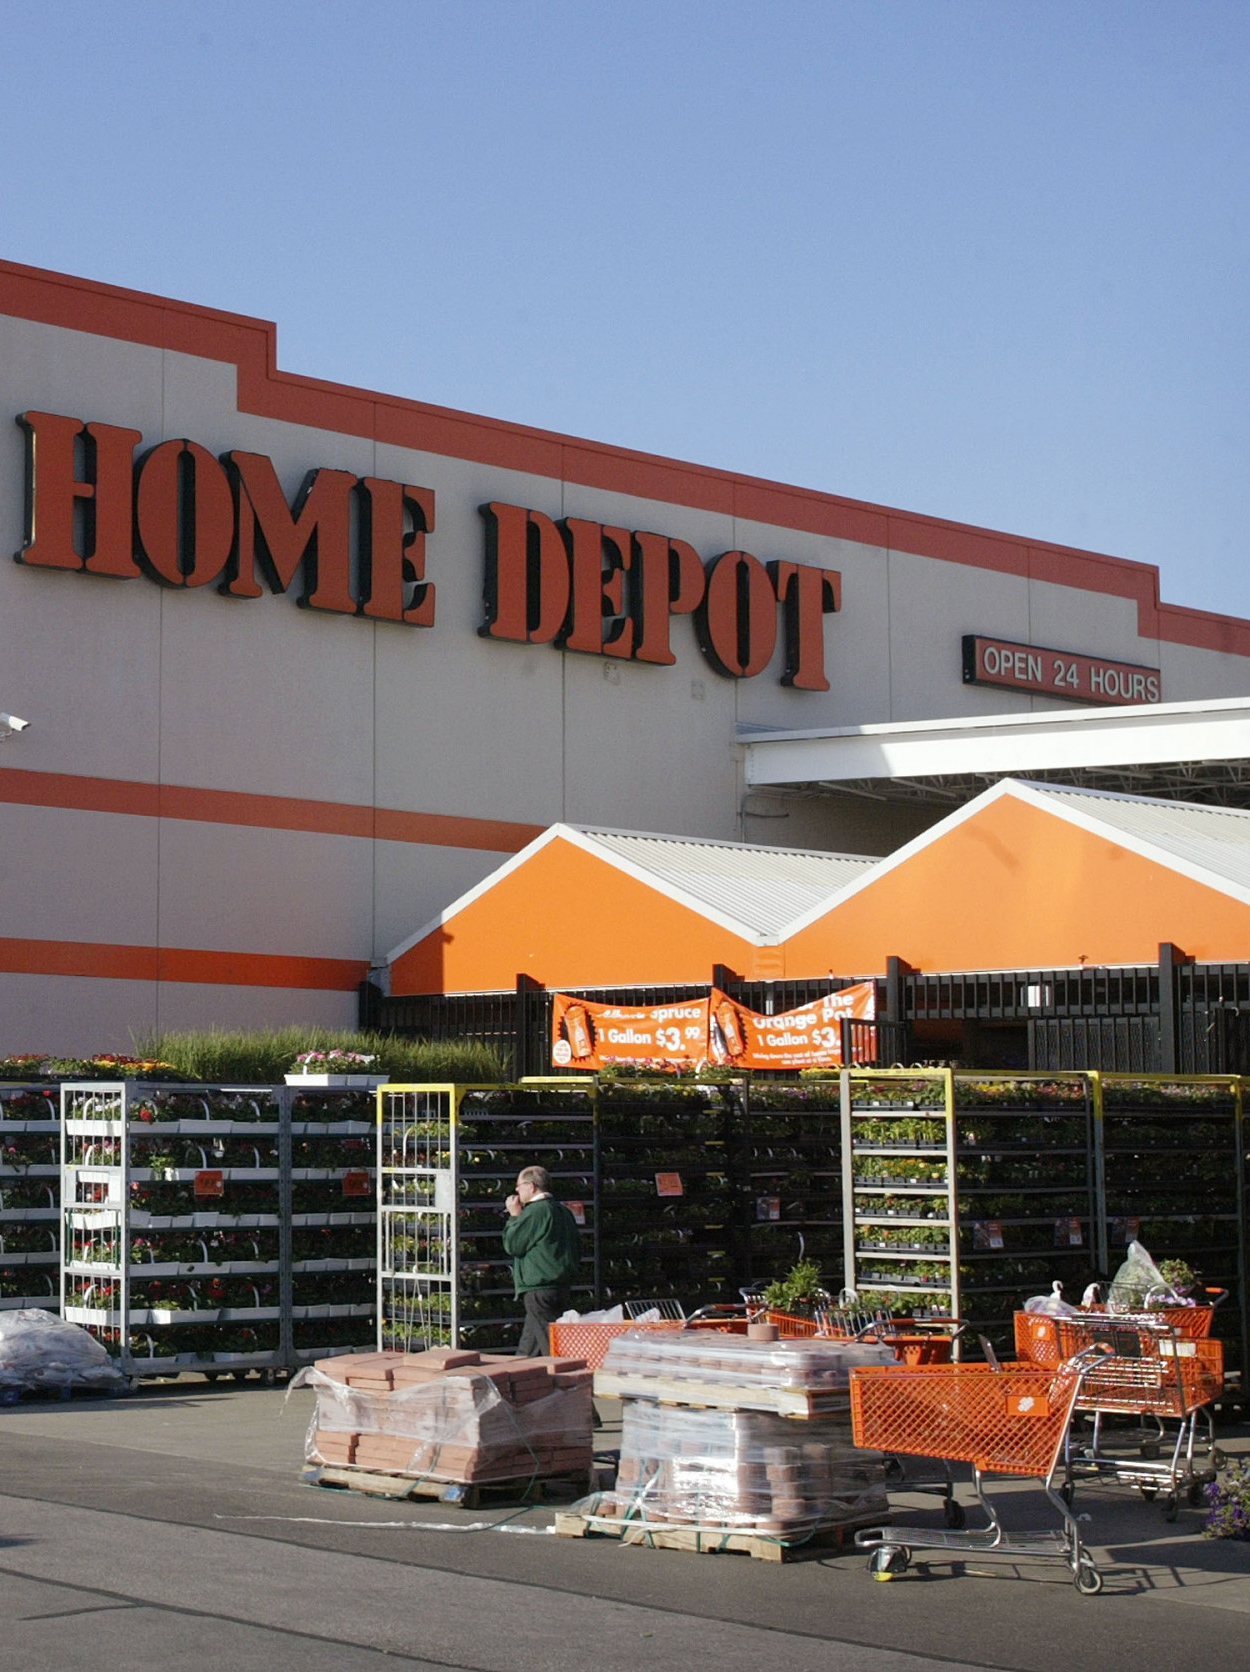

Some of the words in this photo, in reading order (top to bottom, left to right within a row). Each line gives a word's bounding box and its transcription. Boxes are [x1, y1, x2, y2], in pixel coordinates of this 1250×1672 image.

[13, 410, 436, 628] HOME
[477, 501, 842, 692] DEPOT
[984, 647, 1042, 682] OPEN
[1053, 660, 1079, 688] 24
[1090, 666, 1160, 702] HOURS
[598, 1028, 605, 1042] 1
[608, 1028, 652, 1044] Gallon
[757, 1034, 764, 1047] 1
[766, 1032, 808, 1047] Gallon
